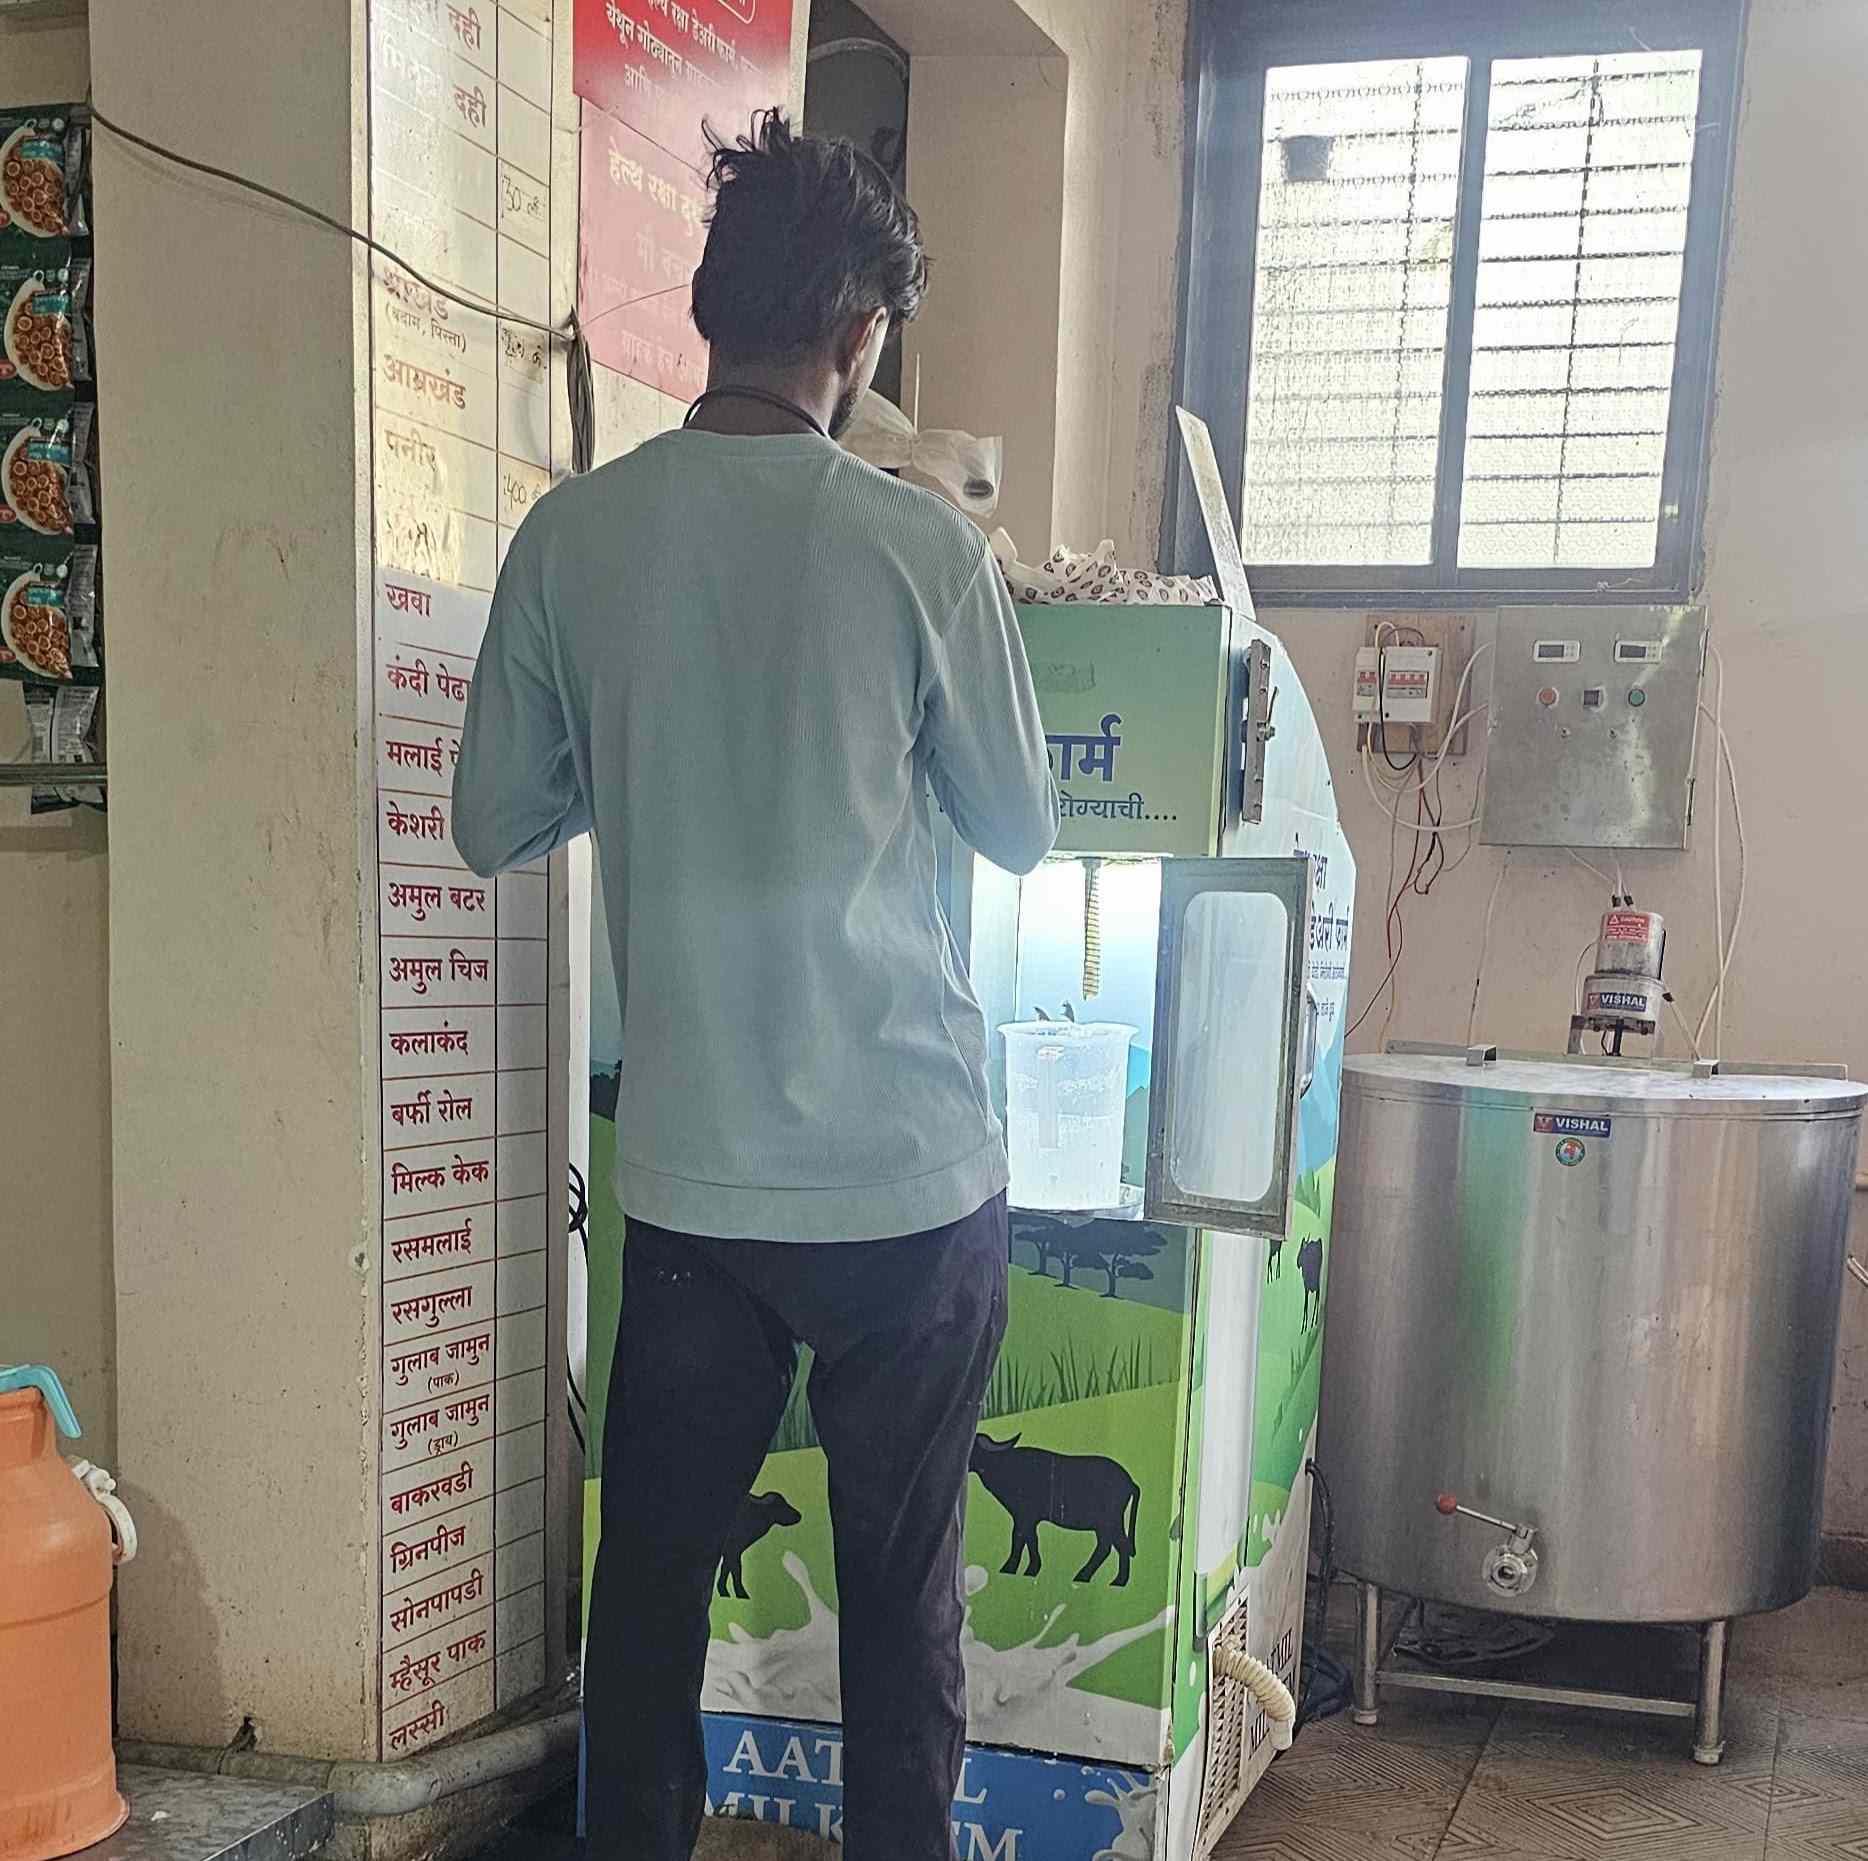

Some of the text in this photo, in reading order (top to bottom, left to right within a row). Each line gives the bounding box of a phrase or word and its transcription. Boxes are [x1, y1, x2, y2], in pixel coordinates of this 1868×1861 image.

[452, 83, 487, 129] दही
[385, 583, 432, 617] खवा
[386, 655, 429, 697] कंदी
[386, 736, 443, 776] मलाई
[1045, 714, 1122, 782] ार्म
[386, 801, 444, 841] केशरी
[1060, 790, 1177, 820] रोग्याची....
[388, 882, 486, 922] अमुल बटर
[389, 949, 489, 995] अमुल चिज
[1600, 993, 1646, 1008] VISHAL
[389, 1020, 469, 1056] कलाकंद
[390, 1089, 473, 1127] बर्फी रोल
[1555, 1117, 1609, 1132] VISHAL
[391, 1154, 489, 1195] मिल्क केक
[391, 1218, 472, 1264] रसमलाई
[391, 1285, 473, 1328] रसगुल्ला
[390, 1333, 491, 1386] गुलाब जामुन
[427, 1370, 460, 1394] (पाक)
[390, 1394, 490, 1450] गुलाब जामुन
[390, 1460, 474, 1514] बाकरवडी
[390, 1524, 466, 1573] ग्रिनपीज
[390, 1568, 485, 1633] सोनपापडी
[389, 1629, 487, 1692] म्हैसूर पाक
[389, 1700, 446, 1750] लस्सी
